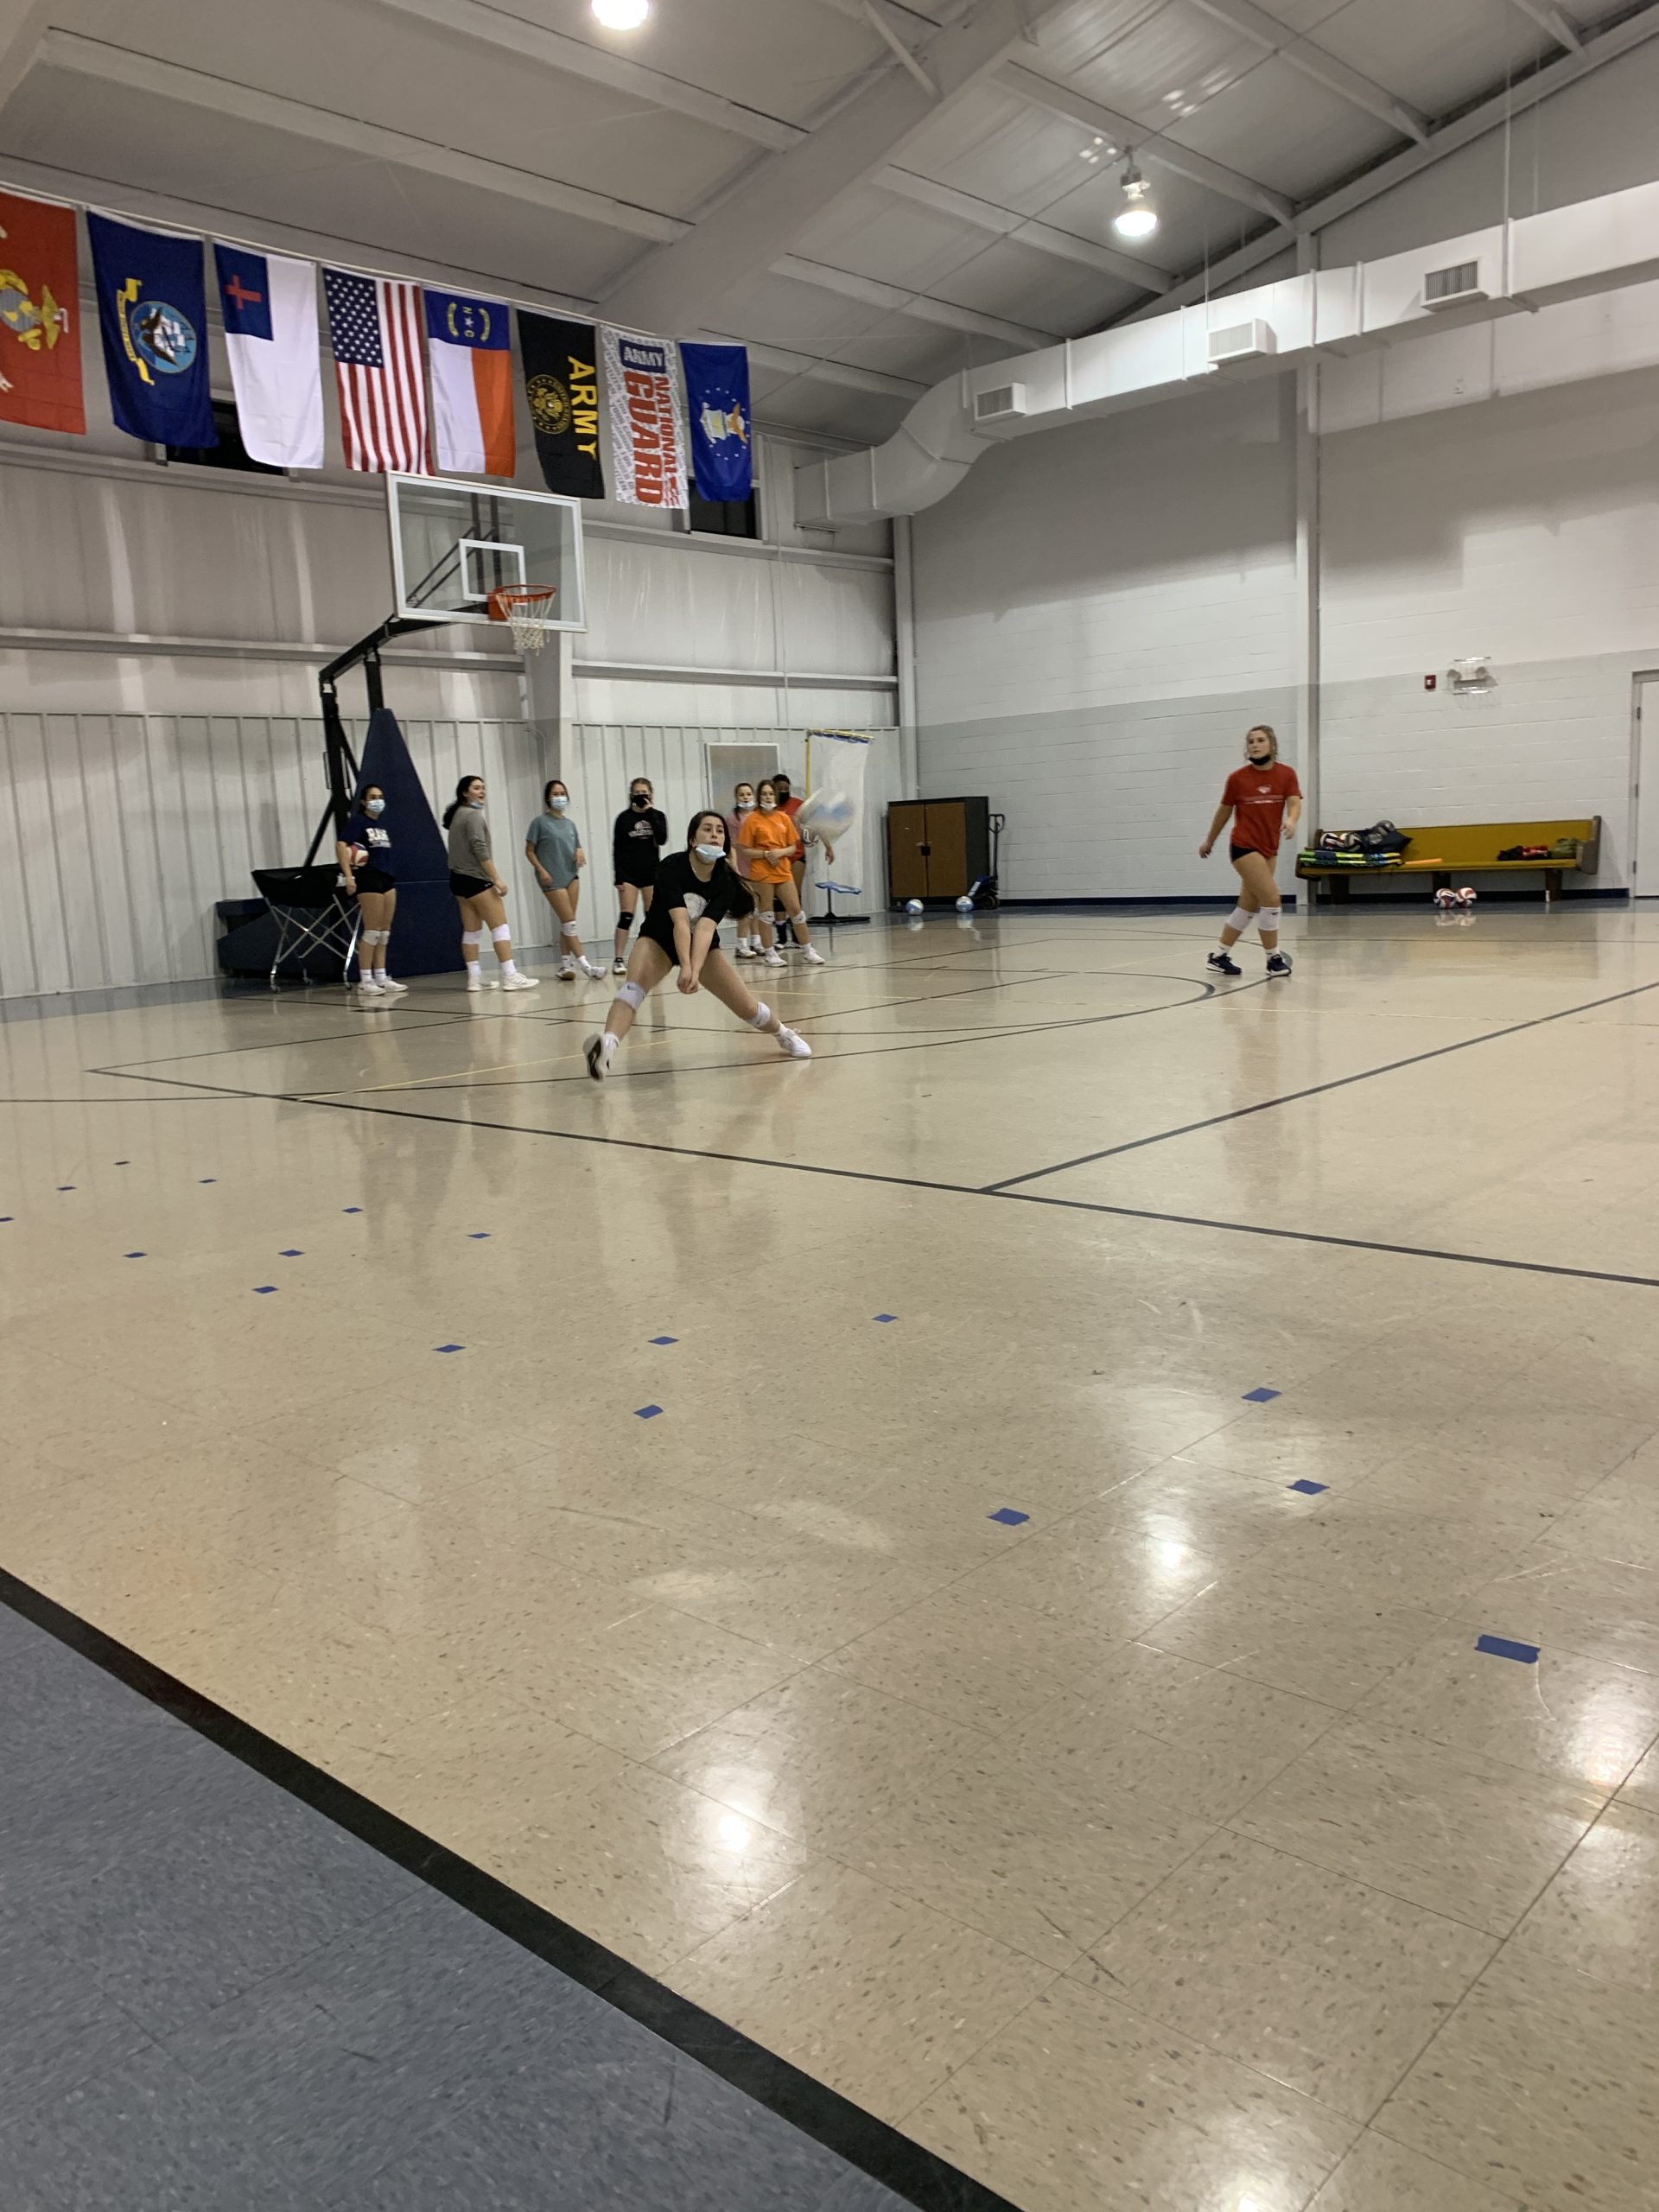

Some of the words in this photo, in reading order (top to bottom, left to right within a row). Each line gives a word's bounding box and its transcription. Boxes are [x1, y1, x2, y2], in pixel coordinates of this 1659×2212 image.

[623, 346, 664, 367] ARMY
[567, 355, 598, 461] ARMY
[623, 371, 664, 504] GUARD
[654, 375, 678, 474] NATIONAL
